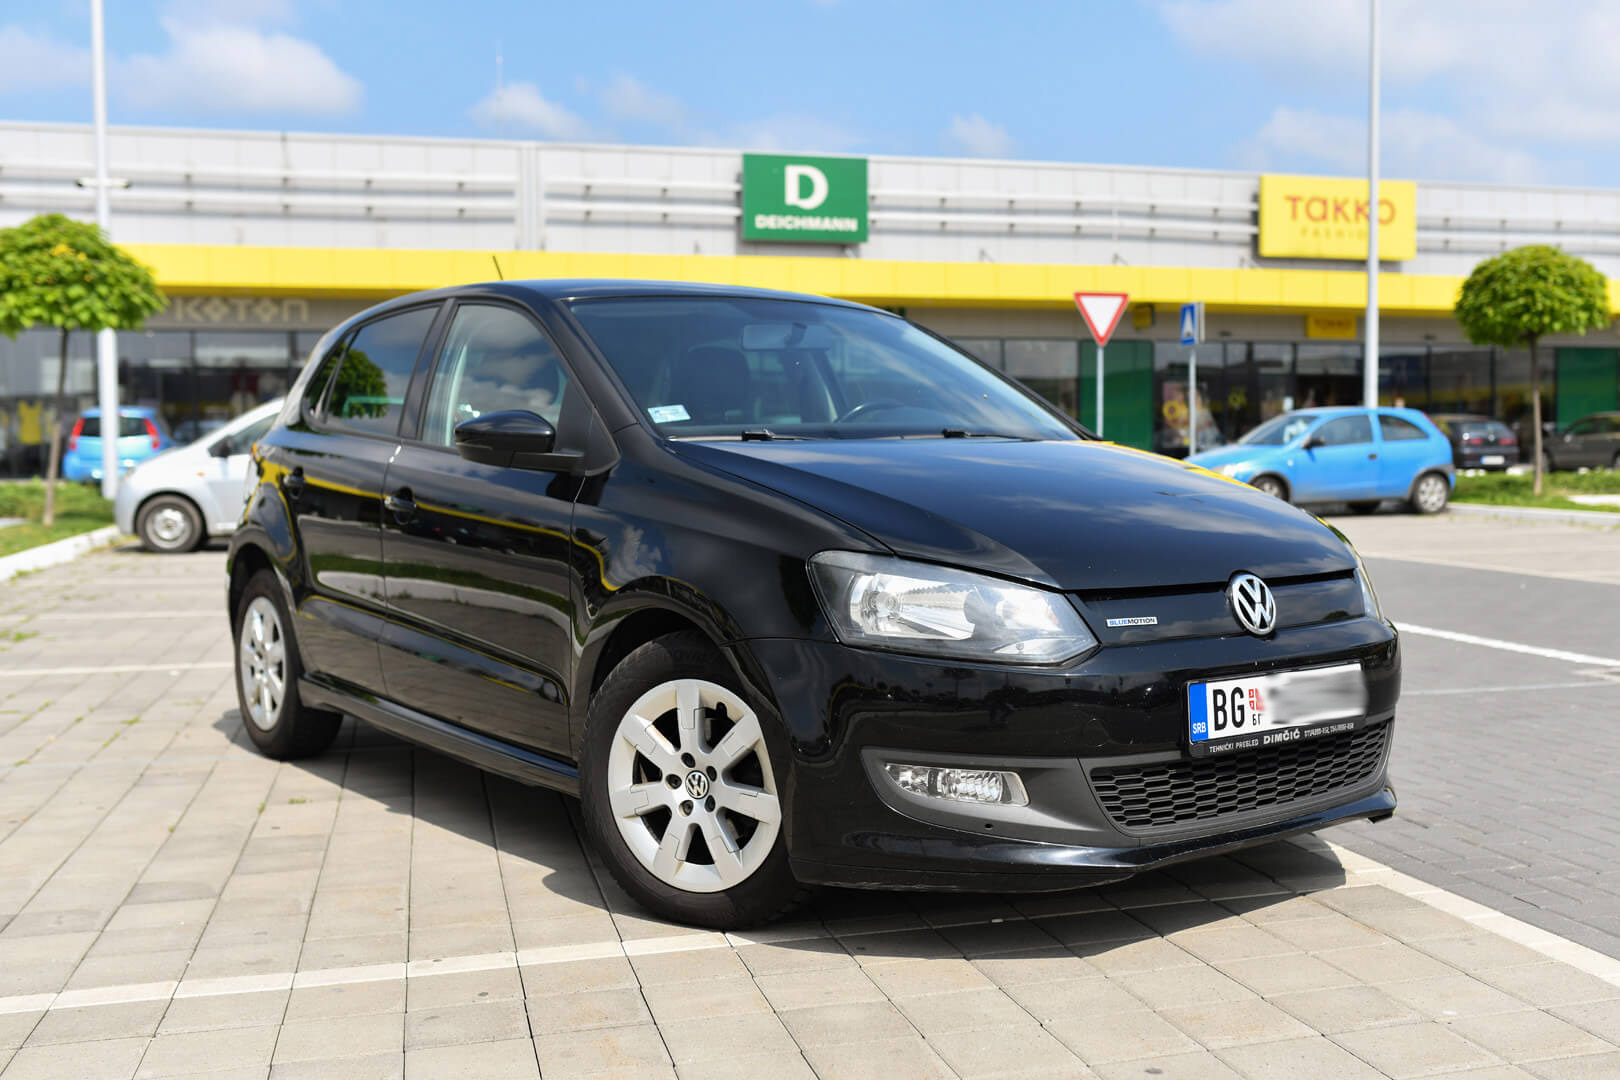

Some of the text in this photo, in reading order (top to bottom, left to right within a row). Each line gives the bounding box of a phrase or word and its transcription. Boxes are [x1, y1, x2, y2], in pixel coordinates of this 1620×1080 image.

[784, 164, 829, 210] D
[755, 214, 858, 232] DEICHMANN
[174, 297, 308, 322] KOTON
[1109, 618, 1155, 626] BLUEMOTION
[1213, 686, 1245, 731] BG
[1192, 721, 1207, 734] SRB
[1263, 729, 1300, 744] DIMČIĆ
